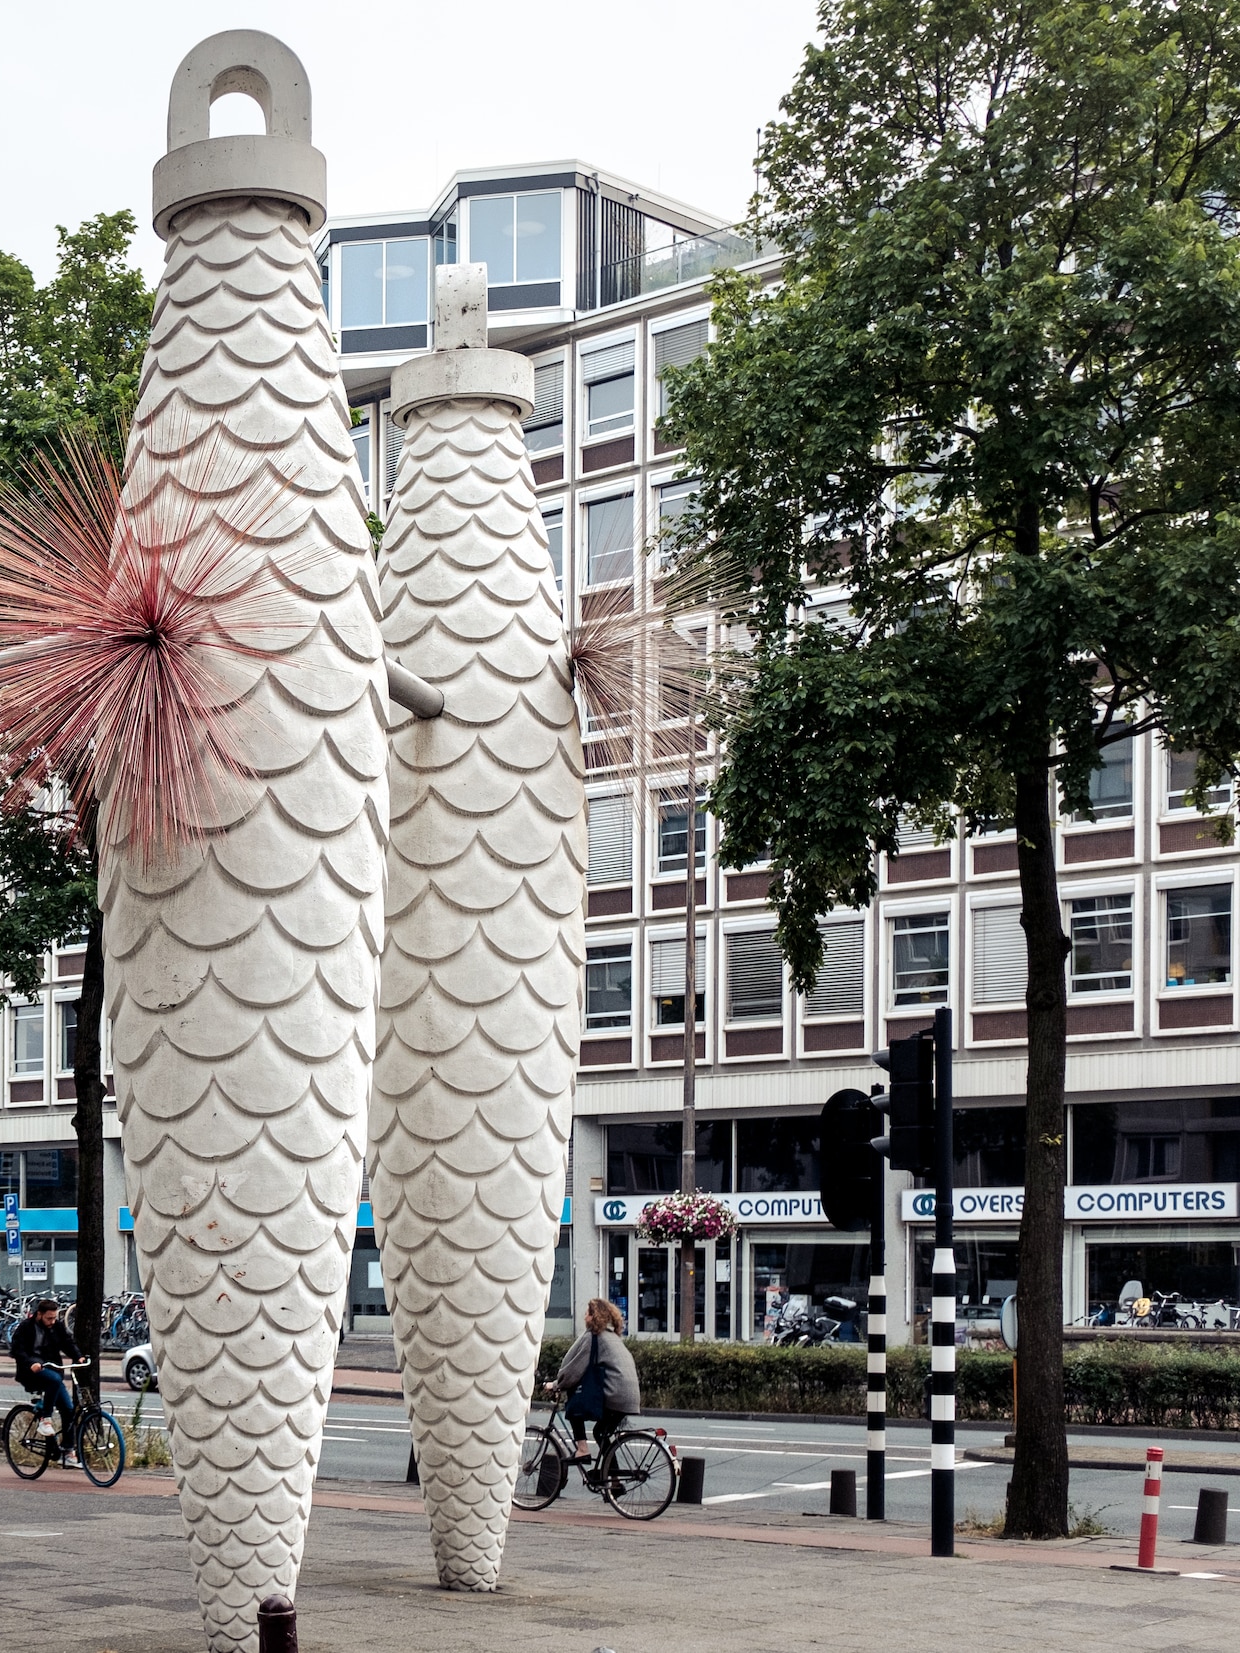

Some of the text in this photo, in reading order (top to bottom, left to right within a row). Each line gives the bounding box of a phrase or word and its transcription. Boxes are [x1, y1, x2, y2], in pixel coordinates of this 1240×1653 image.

[7, 1197, 14, 1211] P
[738, 1198, 821, 1216] COMPUT
[960, 1194, 1025, 1213] OVERS
[1077, 1190, 1225, 1212] COMPUTERS
[9, 1230, 17, 1244] P
